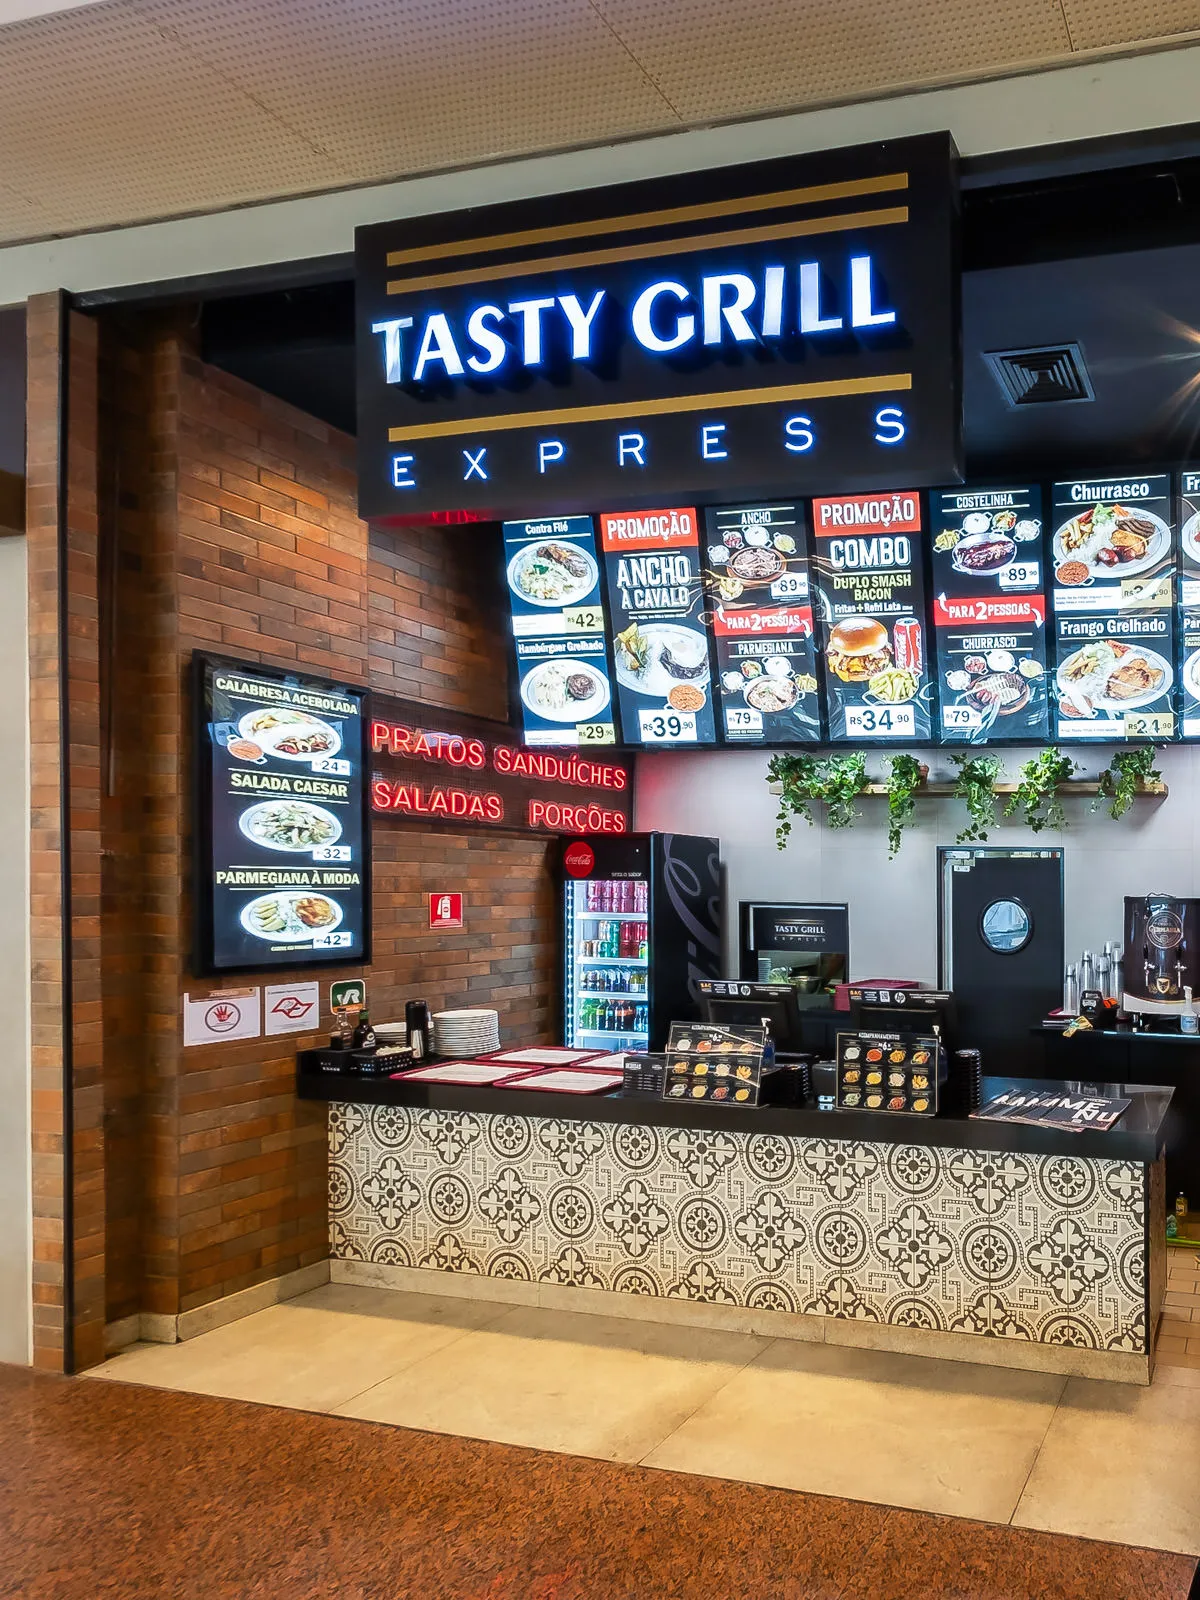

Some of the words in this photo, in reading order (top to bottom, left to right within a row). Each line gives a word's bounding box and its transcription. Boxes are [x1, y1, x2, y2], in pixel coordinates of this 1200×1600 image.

[371, 289, 606, 384] TASTY
[631, 255, 896, 353] GRILL
[391, 408, 906, 488] EXPRESS
[1071, 482, 1150, 501] Churrasco
[956, 493, 1014, 509] COSTELINHA
[741, 511, 771, 525] ANCHO
[820, 496, 915, 527] PROMOÇÃO
[525, 523, 551, 535] Contra
[552, 521, 568, 533] Filé
[607, 510, 691, 541] PROMOÇÃO
[830, 536, 911, 569] COMBO
[617, 555, 692, 589] ANCHO
[1009, 568, 1027, 581] 89
[780, 579, 797, 592] 89
[833, 576, 872, 591] DUPLO
[872, 573, 912, 588] SMASH
[621, 589, 631, 610] À
[633, 587, 690, 610] CAVALO
[854, 587, 892, 601] BACON
[835, 604, 856, 613] Fritas
[884, 602, 901, 611] Lata
[949, 602, 975, 619] PARA
[975, 601, 988, 621] 2
[987, 601, 1031, 617] PESSOAS
[726, 613, 751, 629] PARA
[750, 614, 762, 631] 2
[761, 611, 801, 627] PESSOAS
[1060, 621, 1105, 638] Frango
[1106, 618, 1166, 634] Grelhado
[518, 640, 566, 655] Hambúrguer
[566, 640, 604, 652] Grelhado
[738, 641, 794, 655] PARMEGIANA
[963, 635, 1017, 650] CHURRASCO
[215, 677, 292, 702] CALABRESA
[292, 694, 358, 715] ACEBOLADA
[372, 722, 483, 766] PRATOS
[496, 752, 626, 789] SANDUÍCHES
[321, 760, 339, 772] 24
[230, 773, 291, 792] SALADA
[293, 778, 348, 797] CAESAR
[373, 781, 501, 820] SALADAS
[532, 801, 626, 833] PORÇÕES
[323, 848, 341, 859] 32
[216, 871, 310, 885] PARMEGIANA
[311, 870, 321, 885] À
[323, 872, 360, 885] MODA
[774, 925, 799, 933] TASTY
[800, 926, 826, 934] GRILL
[323, 935, 342, 946] 42
